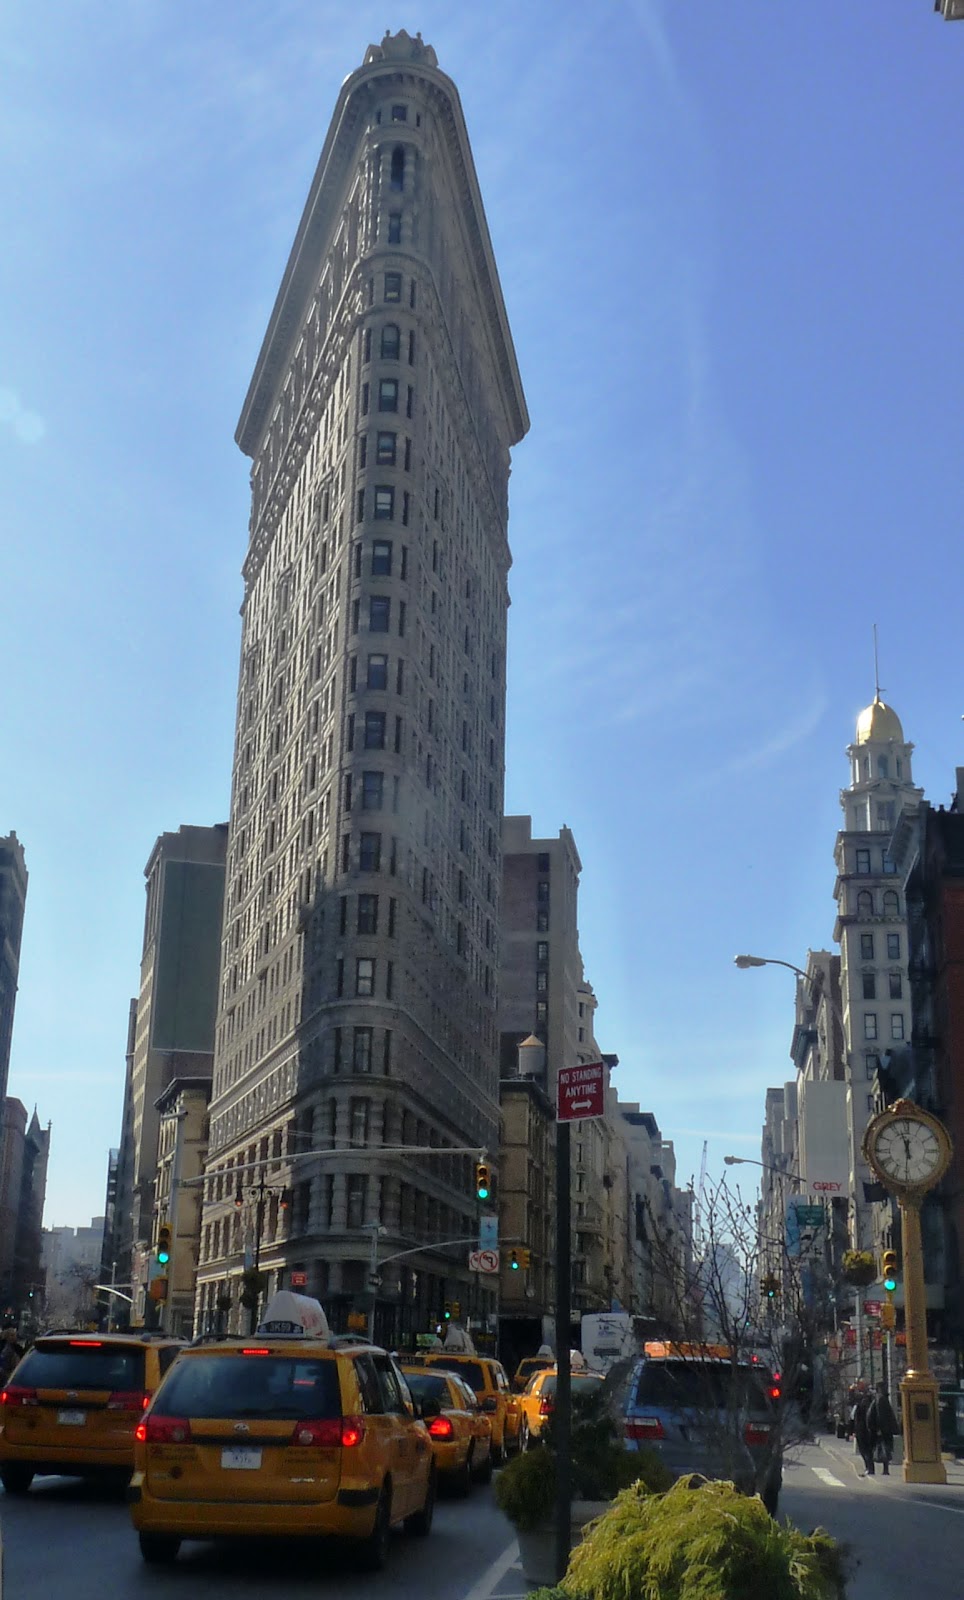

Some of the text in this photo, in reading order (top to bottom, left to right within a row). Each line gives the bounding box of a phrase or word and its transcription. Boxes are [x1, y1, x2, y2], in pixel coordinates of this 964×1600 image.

[560, 1067, 602, 1084] NO STANDING
[565, 1083, 597, 1098] ANYTIME
[812, 1181, 842, 1192] GREY
